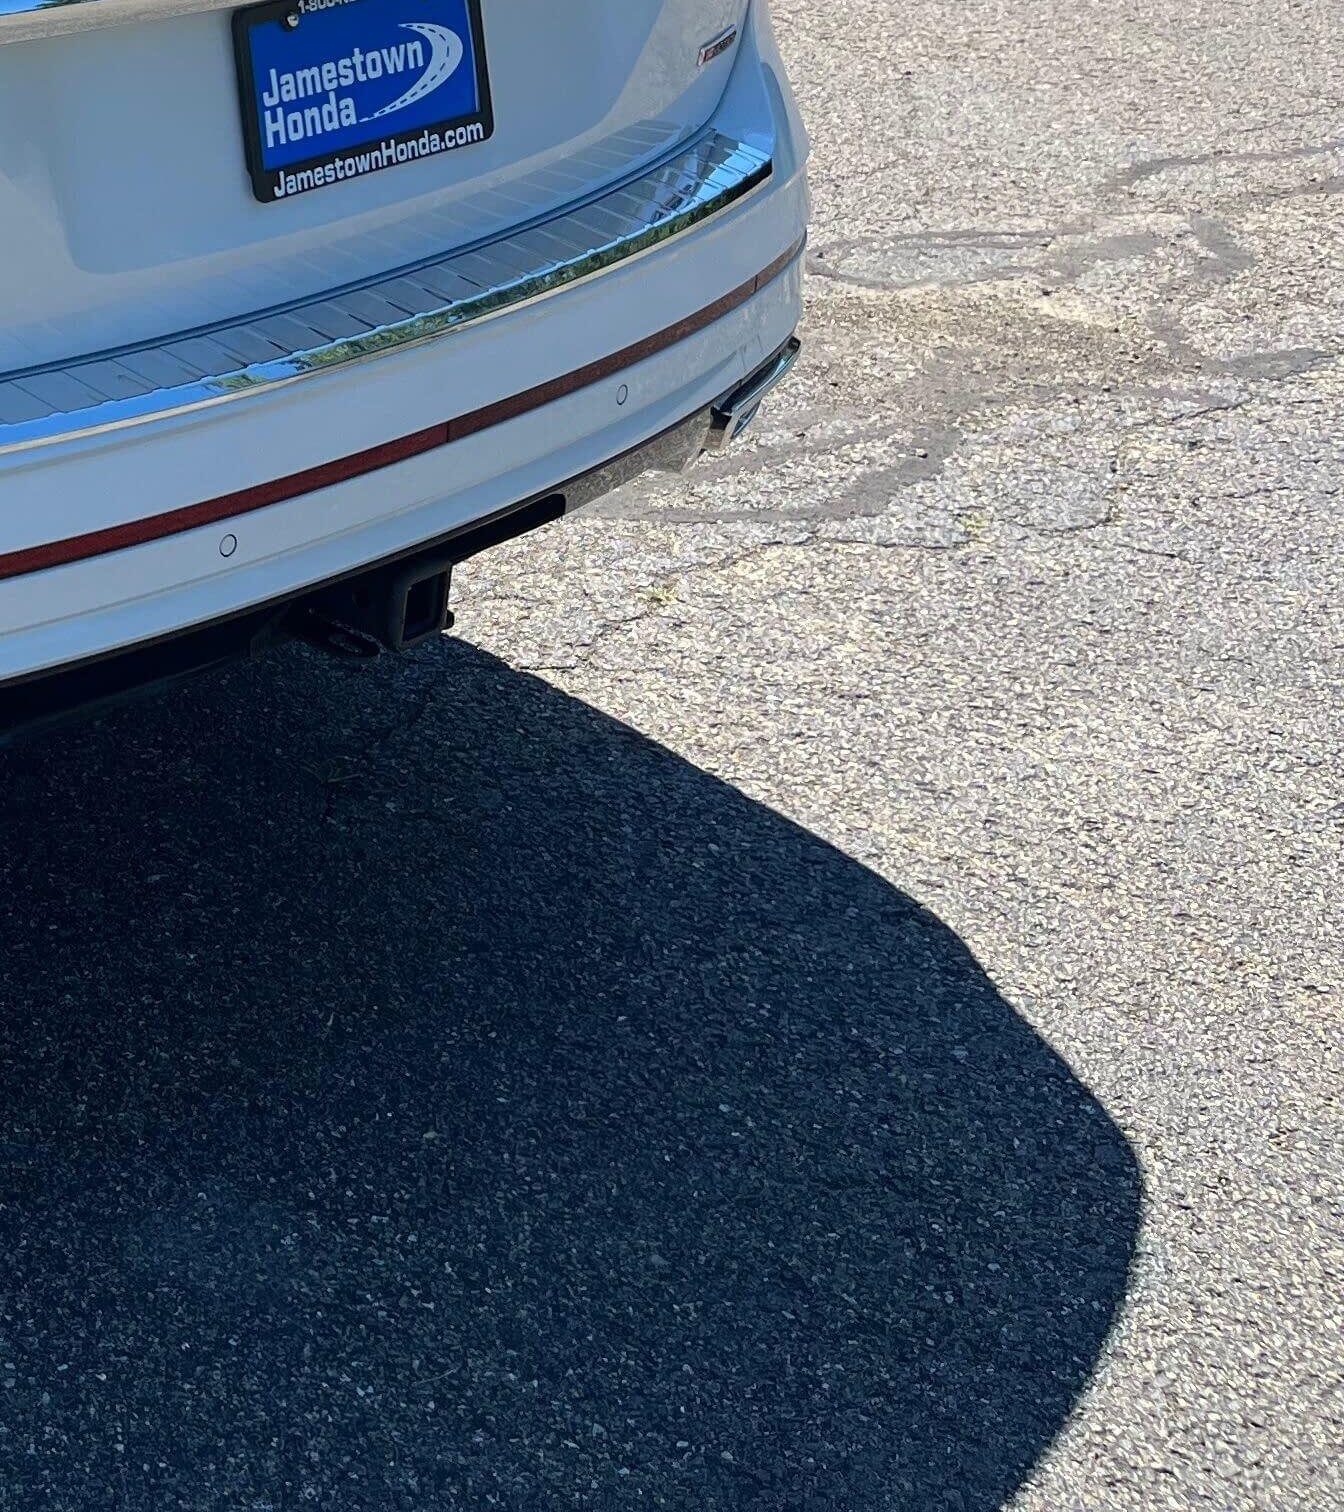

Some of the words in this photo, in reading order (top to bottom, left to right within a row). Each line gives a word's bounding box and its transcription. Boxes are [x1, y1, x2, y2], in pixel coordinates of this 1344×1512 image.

[262, 39, 425, 107] Jamestown
[264, 91, 357, 148] Honda
[273, 121, 484, 198] JamestownHonda.com
